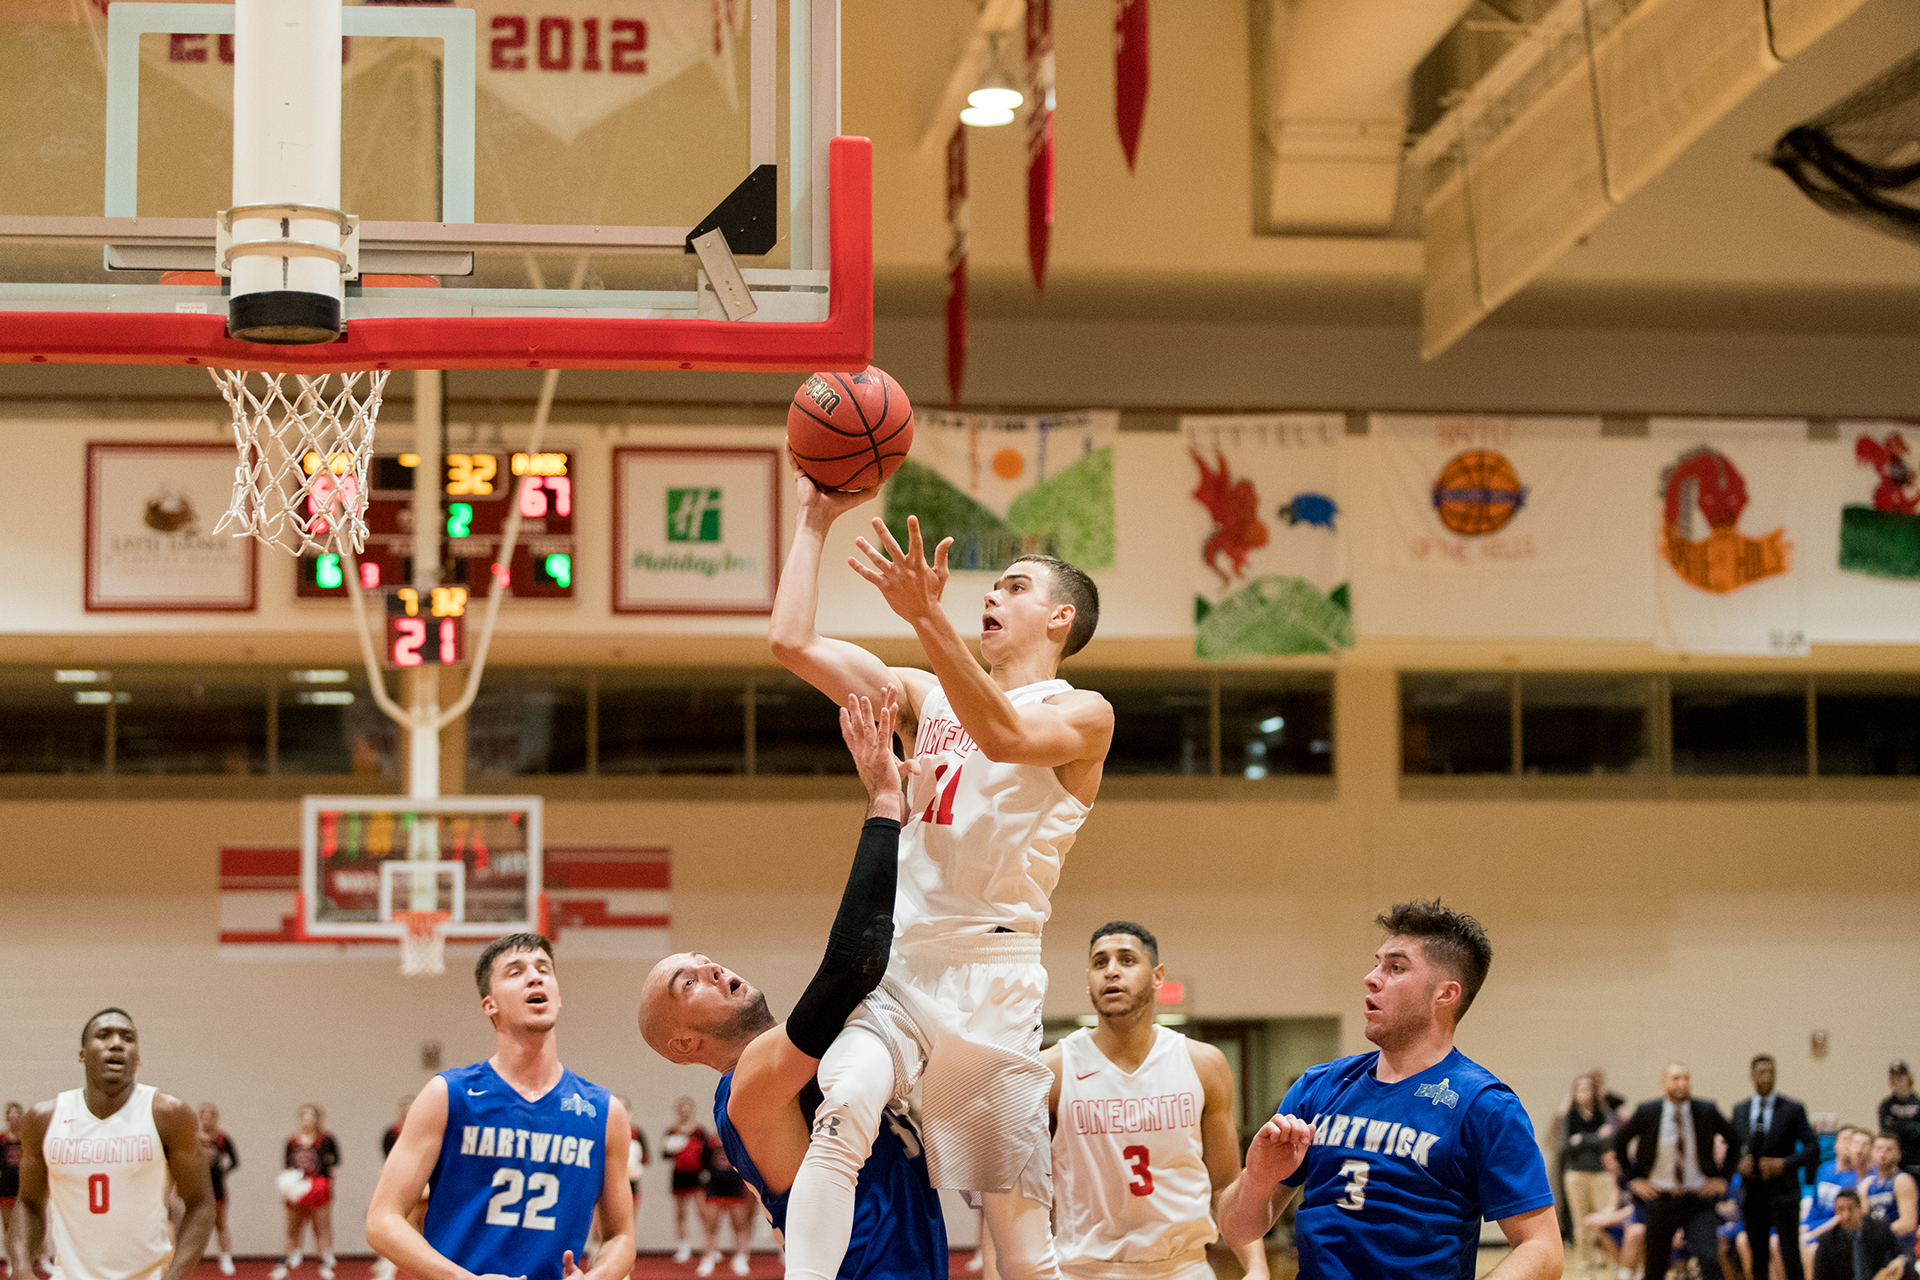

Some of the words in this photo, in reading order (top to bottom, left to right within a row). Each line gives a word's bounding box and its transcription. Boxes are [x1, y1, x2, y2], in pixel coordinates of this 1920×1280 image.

[490, 15, 648, 74] 2012
[518, 475, 571, 517] 67
[447, 502, 473, 538] 2
[316, 553, 343, 589] 6
[545, 553, 571, 588] 9
[394, 617, 456, 667] 21
[1071, 1092, 1196, 1135] ONEONTA
[50, 1134, 153, 1165] ONEONTA
[460, 1125, 595, 1169] HARTWICK
[1311, 1113, 1441, 1167] ARTWICK
[1123, 1145, 1154, 1197] 3
[1336, 1159, 1370, 1211] 3
[88, 1173, 111, 1214] 0
[485, 1167, 560, 1231] 22
